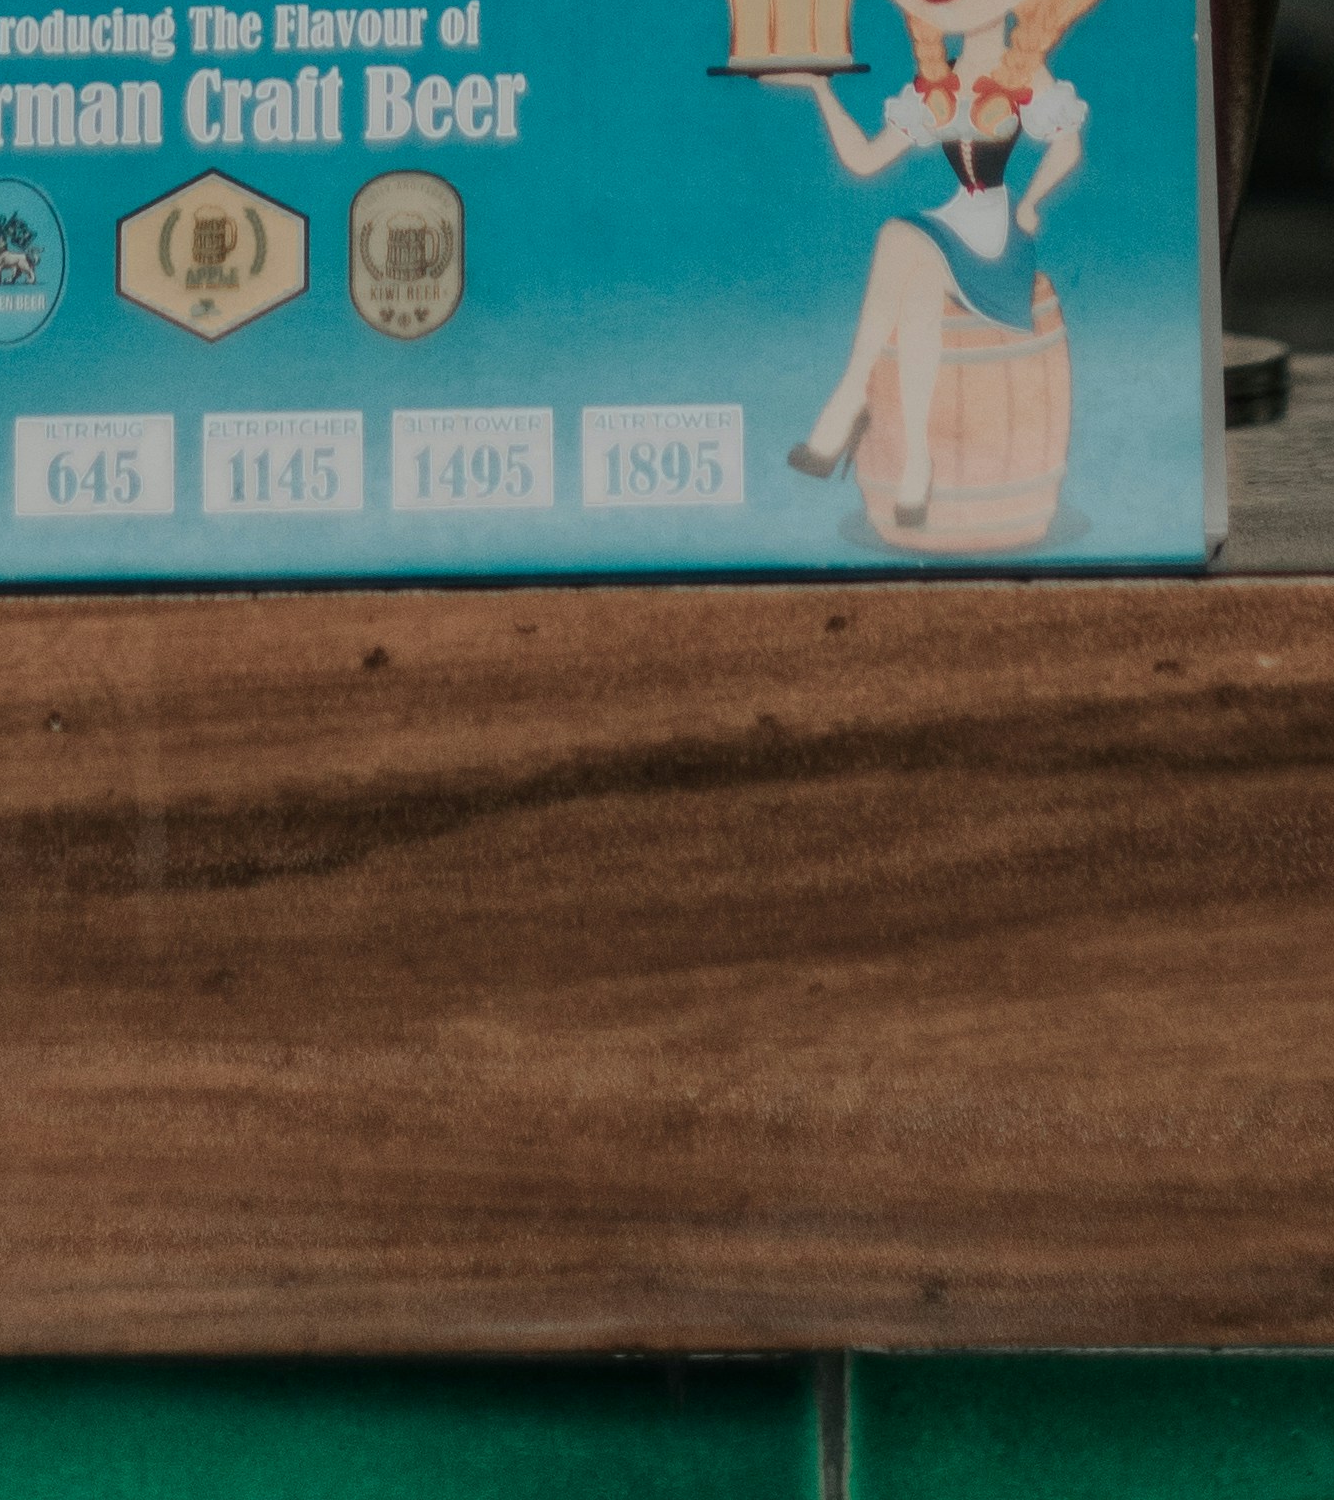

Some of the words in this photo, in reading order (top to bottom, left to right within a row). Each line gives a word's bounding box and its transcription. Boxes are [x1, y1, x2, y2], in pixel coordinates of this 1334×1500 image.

[188, 4, 263, 51] The
[274, 3, 428, 49] Flavour
[439, 0, 481, 47] of
[186, 65, 343, 143] Craft
[364, 65, 527, 140] Beer
[370, 284, 400, 301] KIWI
[94, 421, 143, 440] MUG
[208, 419, 259, 438] 2LTR
[265, 417, 358, 437] PITCHER
[403, 415, 455, 434] 3LTR
[462, 414, 543, 432] TOWER
[594, 412, 646, 431] 4LTR
[651, 411, 733, 429] TOWER
[47, 450, 144, 506] 645
[227, 446, 341, 503] 1145
[414, 443, 535, 500] 1495
[604, 440, 725, 497] 1895
